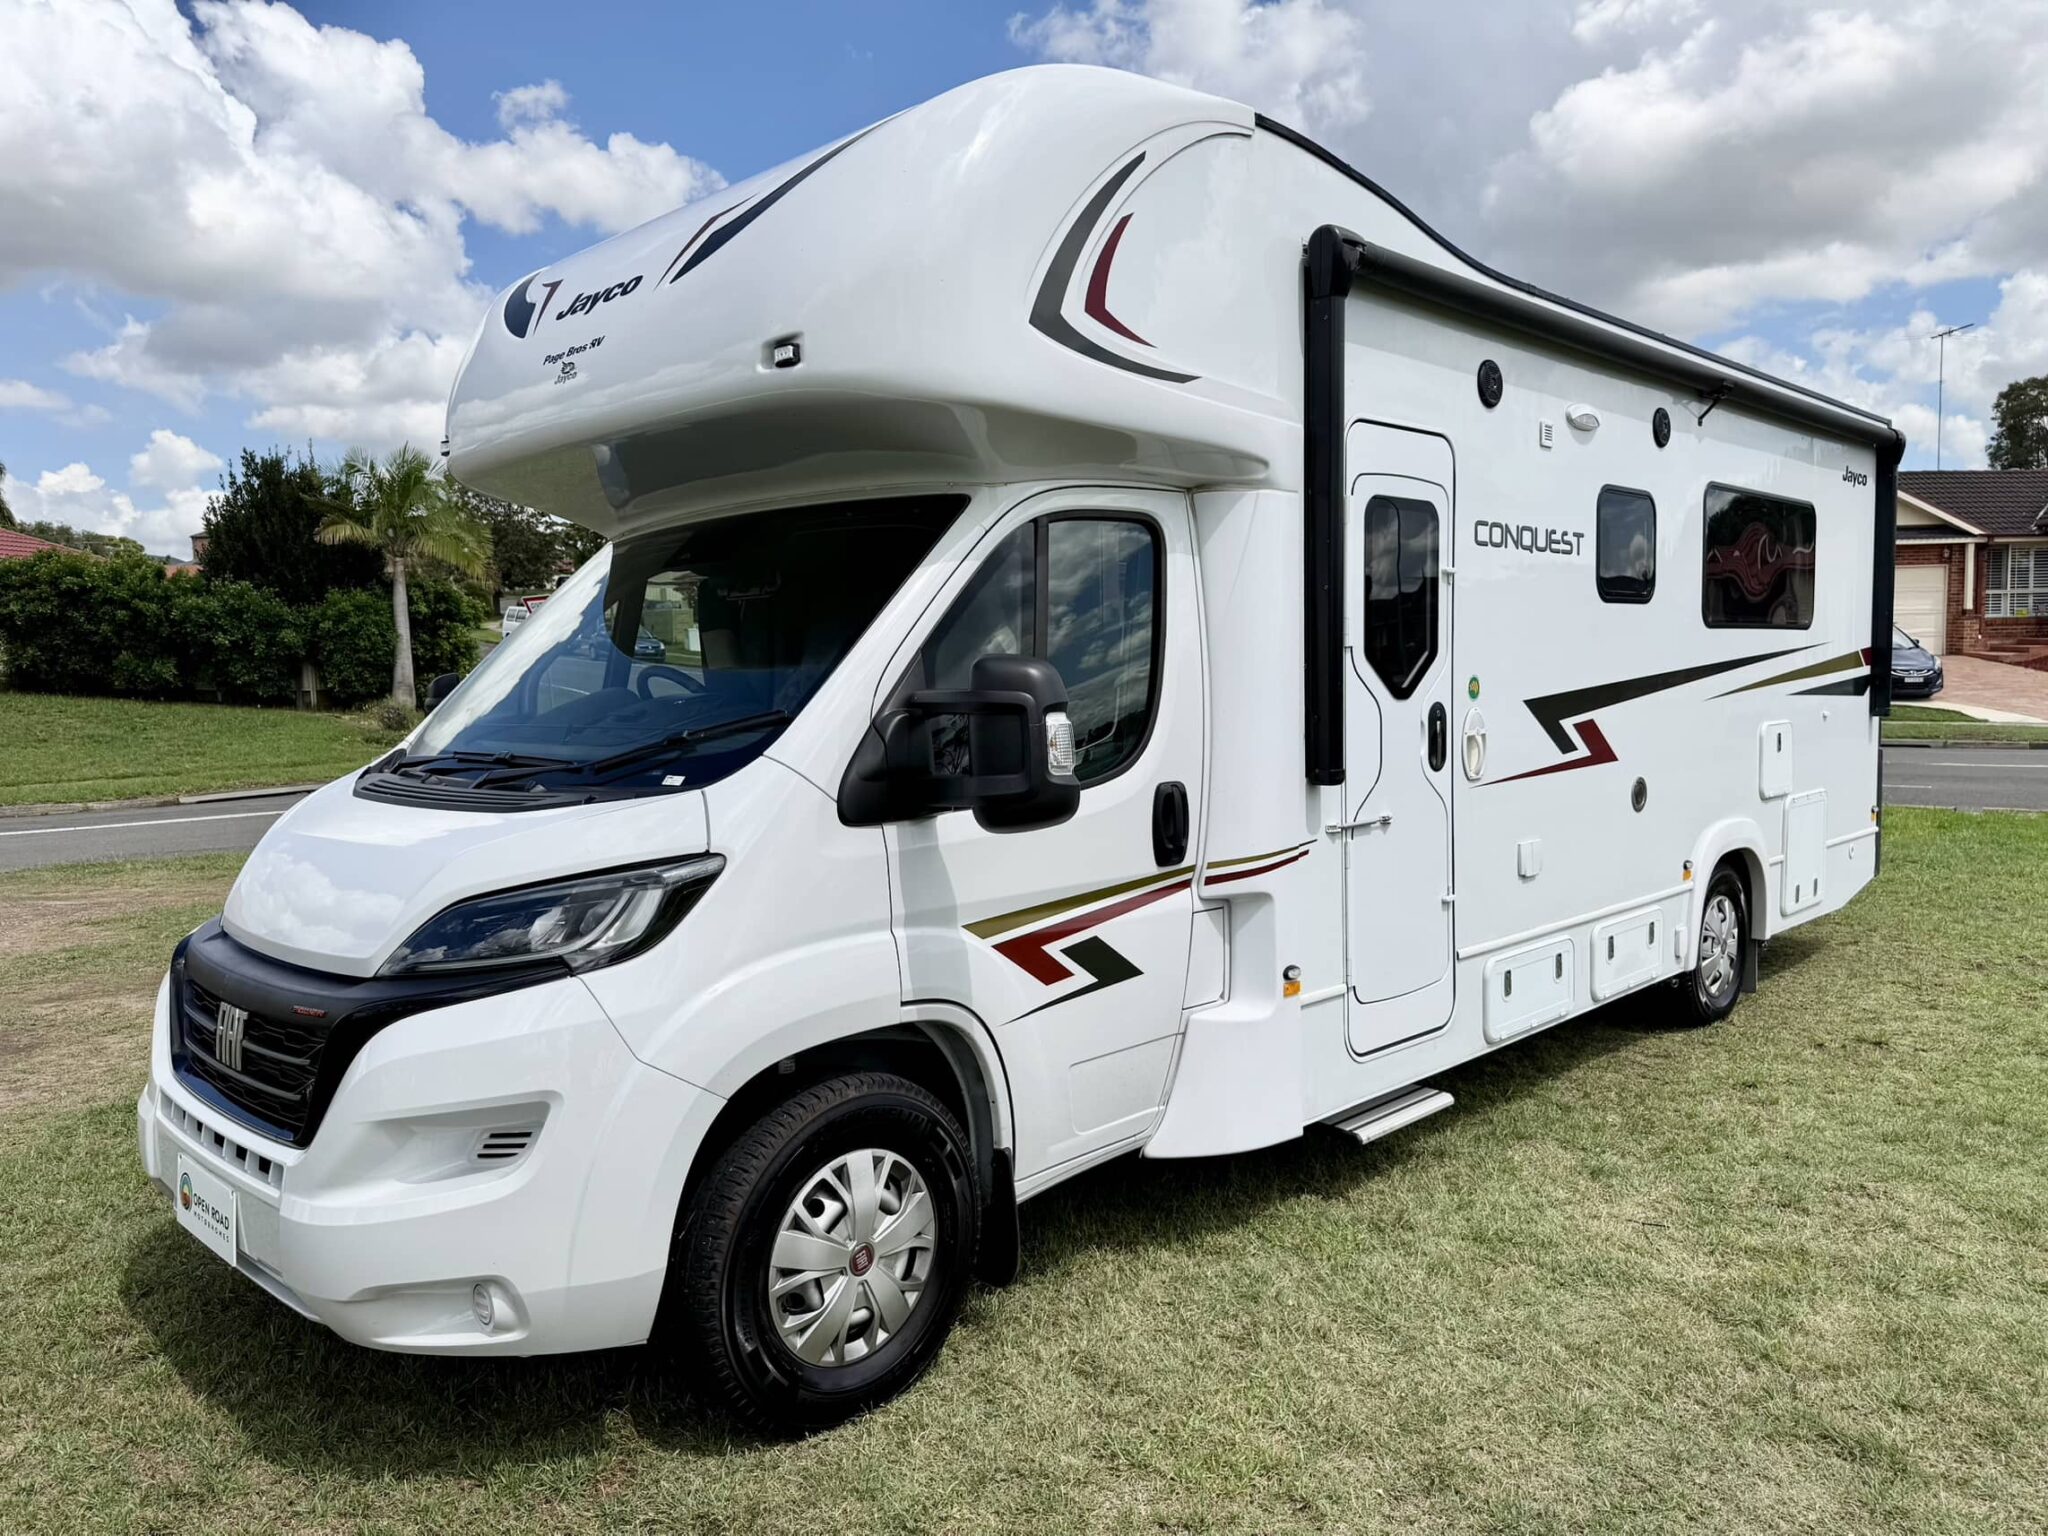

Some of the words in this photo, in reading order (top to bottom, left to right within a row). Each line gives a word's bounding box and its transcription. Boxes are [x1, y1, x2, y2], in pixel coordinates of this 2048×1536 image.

[556, 275, 643, 320] Jayco
[1842, 465, 1867, 488] Jayco
[1474, 519, 1584, 556] CONQUEST
[216, 1001, 248, 1071] FIAT
[193, 1192, 210, 1216] OPEN
[211, 1206, 230, 1230] ROAD
